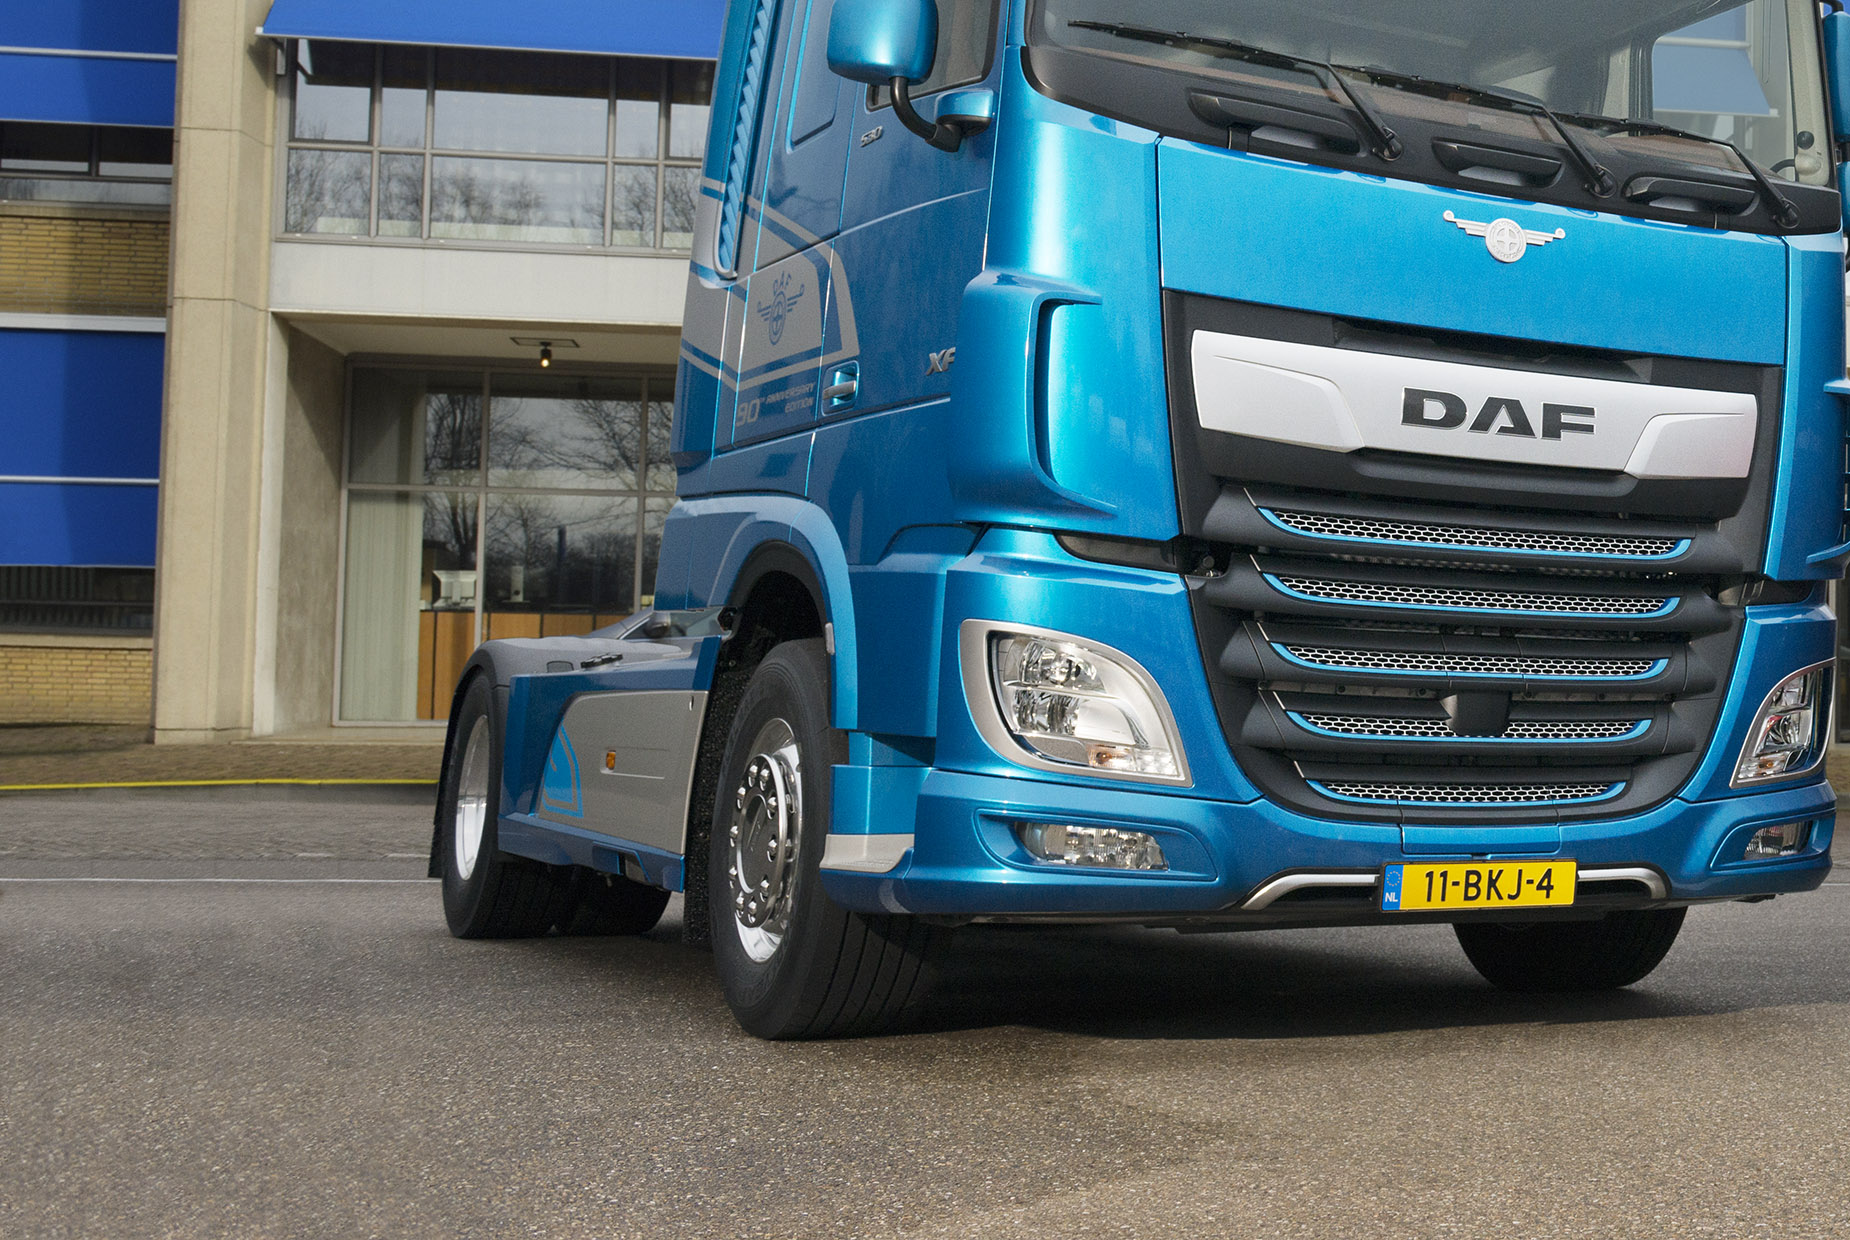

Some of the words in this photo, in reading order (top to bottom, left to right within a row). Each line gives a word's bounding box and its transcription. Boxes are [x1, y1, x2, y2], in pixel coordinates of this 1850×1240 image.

[925, 346, 956, 376] XF
[1401, 386, 1596, 442] DAF
[1385, 891, 1398, 903] NL
[1425, 867, 1554, 903] 11-BKJ-4
